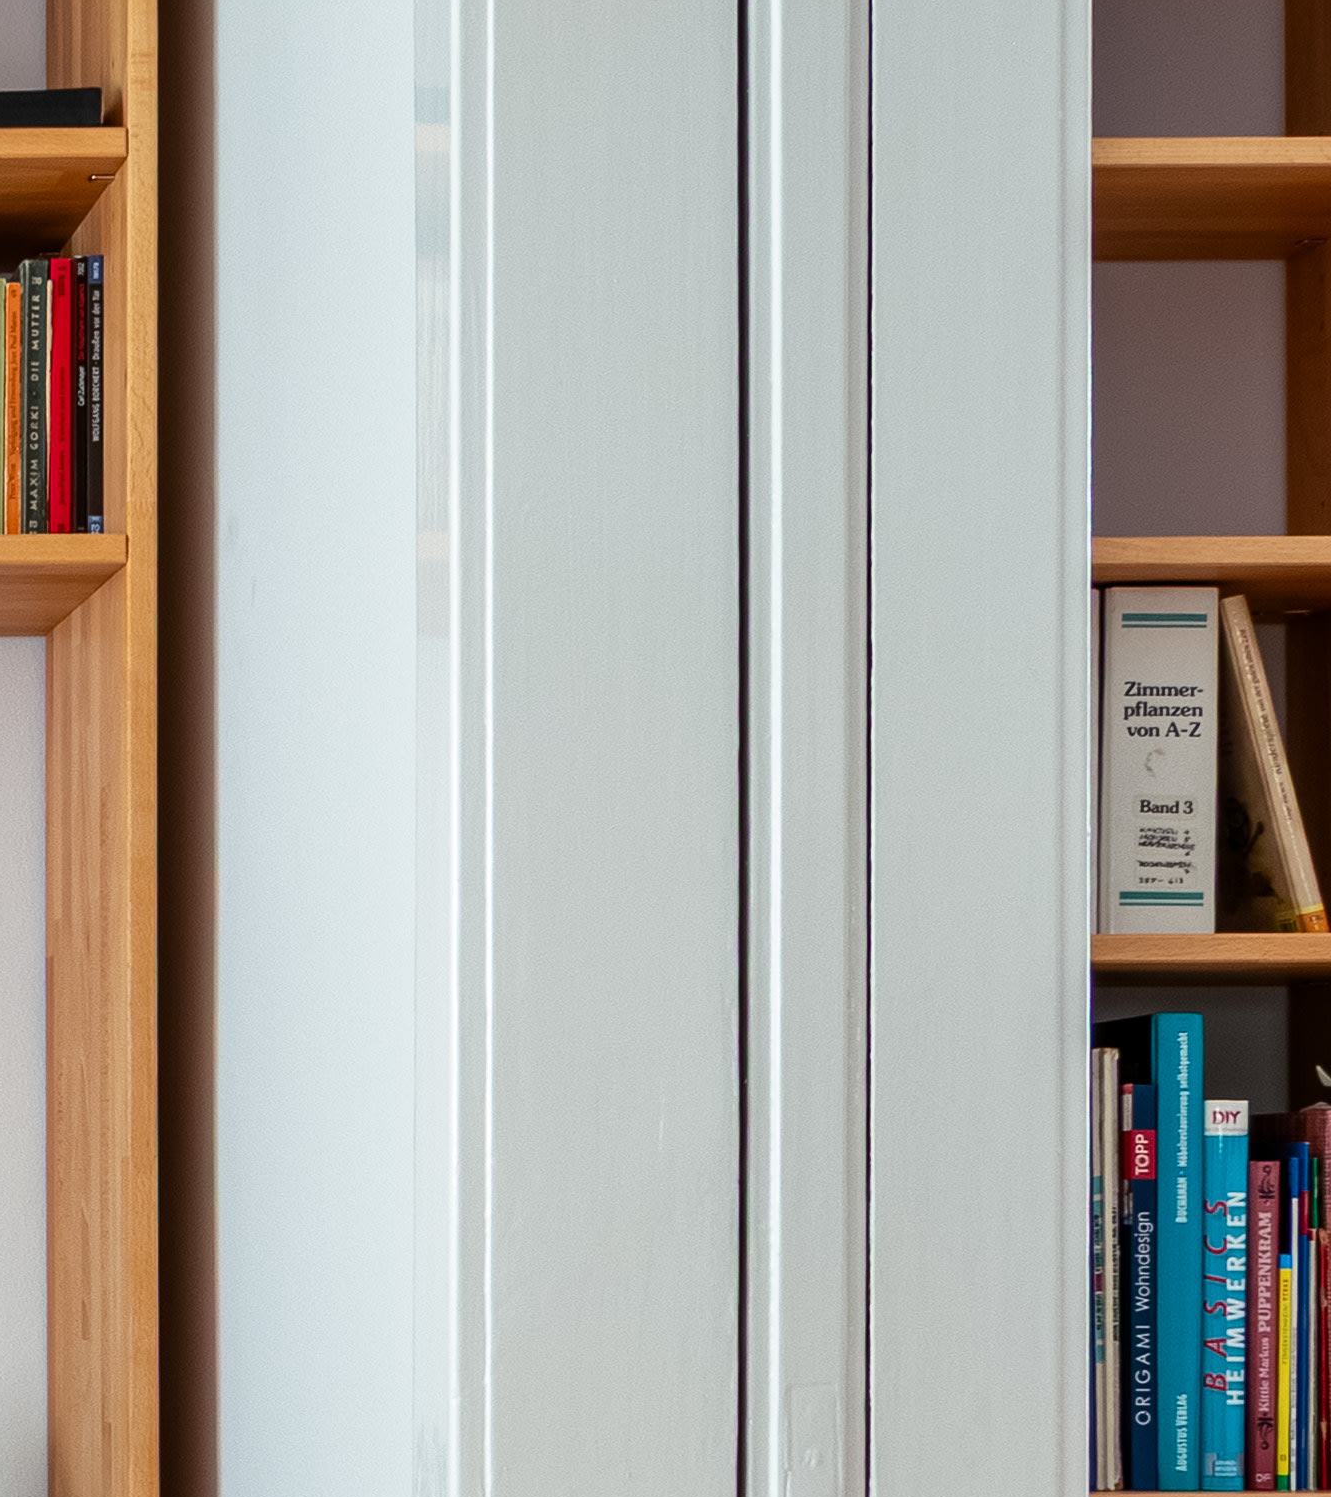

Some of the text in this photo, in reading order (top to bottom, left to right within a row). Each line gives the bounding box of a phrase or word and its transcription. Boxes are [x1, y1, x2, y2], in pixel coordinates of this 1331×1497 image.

[29, 294, 41, 511] MAXIM GORKI DIE MUTTER
[1124, 682, 1203, 698] Zimmer-
[1124, 701, 1203, 720] pflanzen
[1127, 722, 1202, 737] von A-Z
[1140, 800, 1194, 814] Band 3
[1212, 1111, 1240, 1125] DIY
[1135, 1133, 1150, 1176] TOPP
[1258, 1213, 1272, 1333] PUPPENKRAM
[1204, 1201, 1228, 1392] BASICS
[1226, 1192, 1246, 1405] HEIMWERKEN
[1135, 1212, 1154, 1425] ORIGAMI Wohndesign
[1259, 1337, 1270, 1377] Markus
[1176, 1394, 1187, 1472] AUGUSTUS VERLAG
